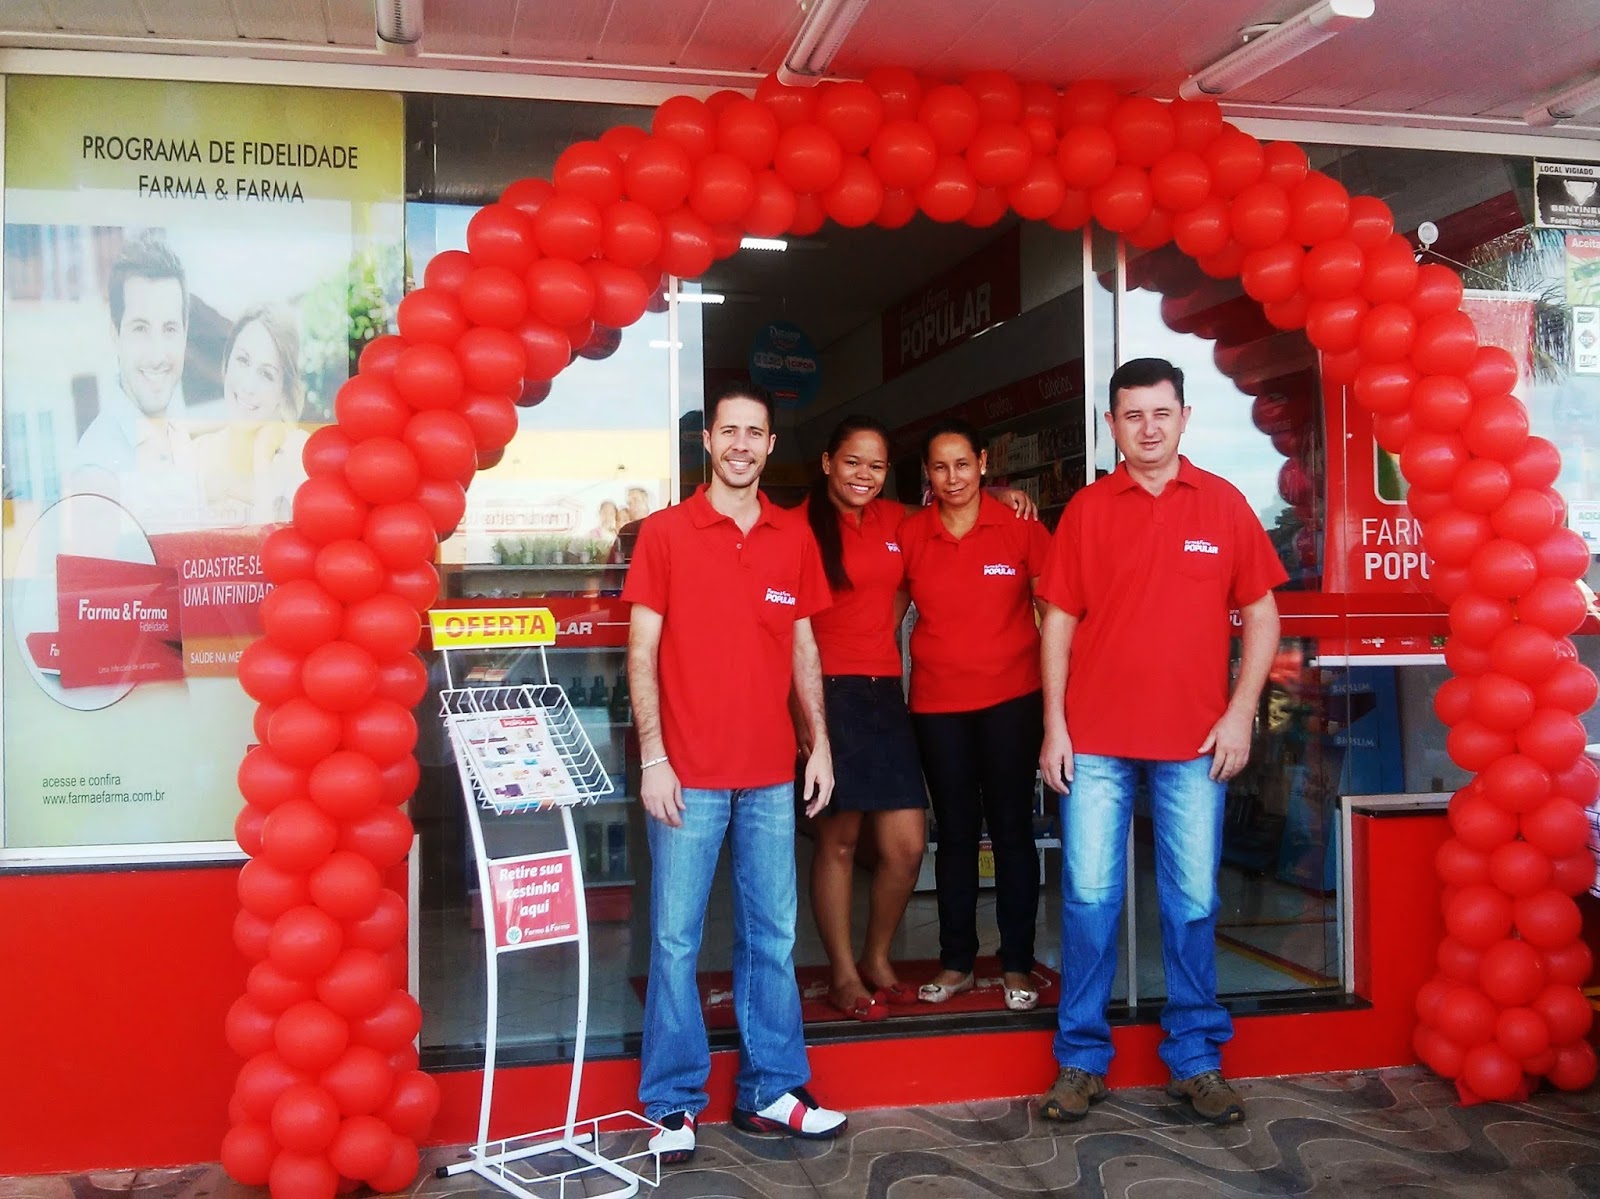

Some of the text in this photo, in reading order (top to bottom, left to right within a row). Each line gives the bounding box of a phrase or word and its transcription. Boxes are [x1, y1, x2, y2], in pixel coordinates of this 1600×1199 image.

[83, 135, 359, 170] PROGRAMA DE FIDELIDADE
[1540, 165, 1594, 175] LOCAL VIGIADO
[138, 175, 304, 203] FARMA & FARMA
[900, 281, 992, 369] POPULAR
[1184, 544, 1219, 555] POPULAR
[983, 568, 1016, 576] POPULAR
[183, 586, 210, 607] UMA
[765, 593, 796, 606] POPULAR
[78, 599, 168, 621] Farma & Farma
[445, 614, 547, 639] OFERTA
[190, 649, 214, 664] SAÚDE
[215, 652, 227, 663] NA
[42, 773, 121, 788] acesse e confira
[43, 789, 165, 805] www.farmaefarma.com.br
[499, 862, 563, 882] Retire sua
[506, 880, 560, 899] cestinha
[520, 900, 550, 919] aqui
